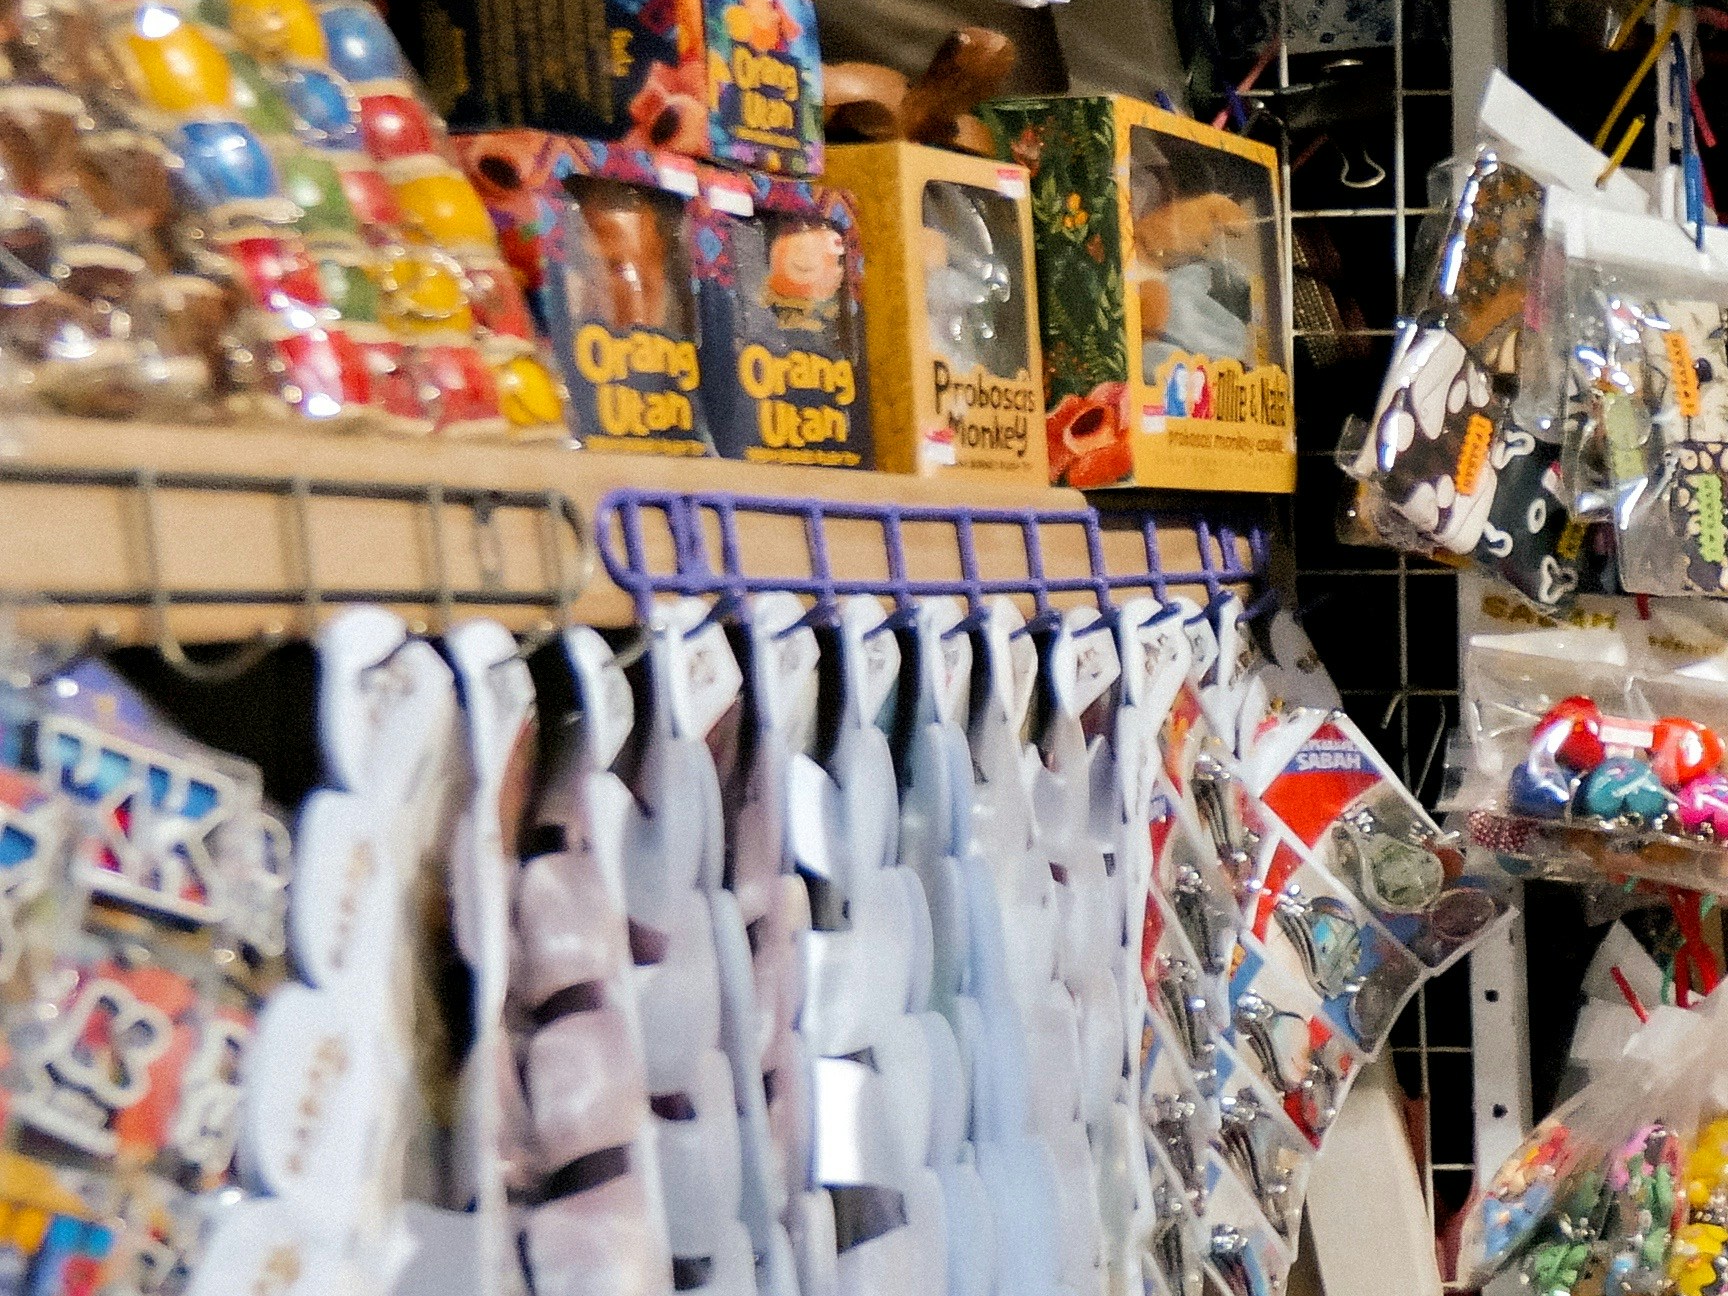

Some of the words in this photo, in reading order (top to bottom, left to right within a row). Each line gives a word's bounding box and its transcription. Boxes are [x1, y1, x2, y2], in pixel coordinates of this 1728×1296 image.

[732, 45, 799, 101] Orang
[742, 90, 795, 130] Utan
[575, 323, 700, 392] Orang
[738, 343, 856, 406] Orang
[596, 383, 692, 437] Utan
[934, 360, 1034, 414] Proboscis
[758, 398, 849, 448] Utan
[948, 412, 1027, 457] Monkey
[1295, 752, 1361, 772] SABAH
